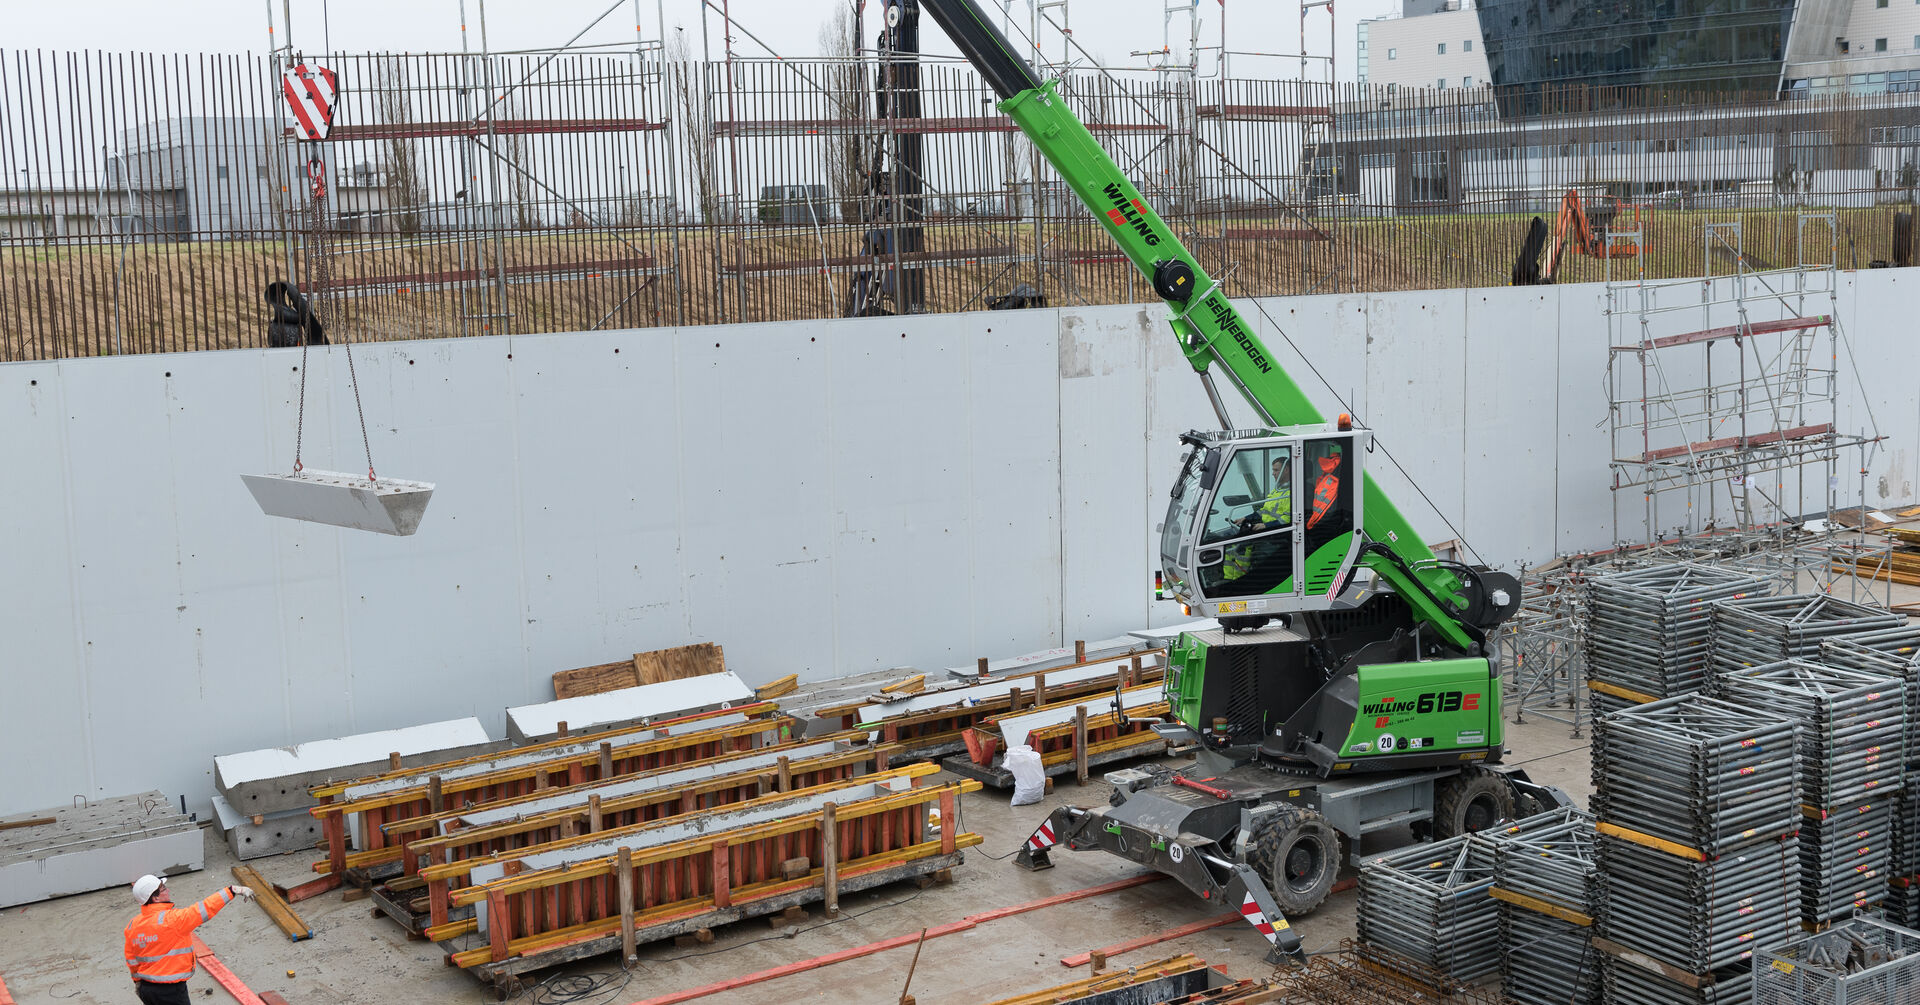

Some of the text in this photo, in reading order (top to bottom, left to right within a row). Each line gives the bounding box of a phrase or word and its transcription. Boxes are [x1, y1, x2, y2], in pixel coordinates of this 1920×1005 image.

[1103, 182, 1161, 247] WILLING
[1205, 297, 1272, 374] SENNEBOGEN
[1363, 701, 1416, 715] WILLING
[1381, 737, 1392, 749] 20
[1172, 846, 1181, 859] 20
